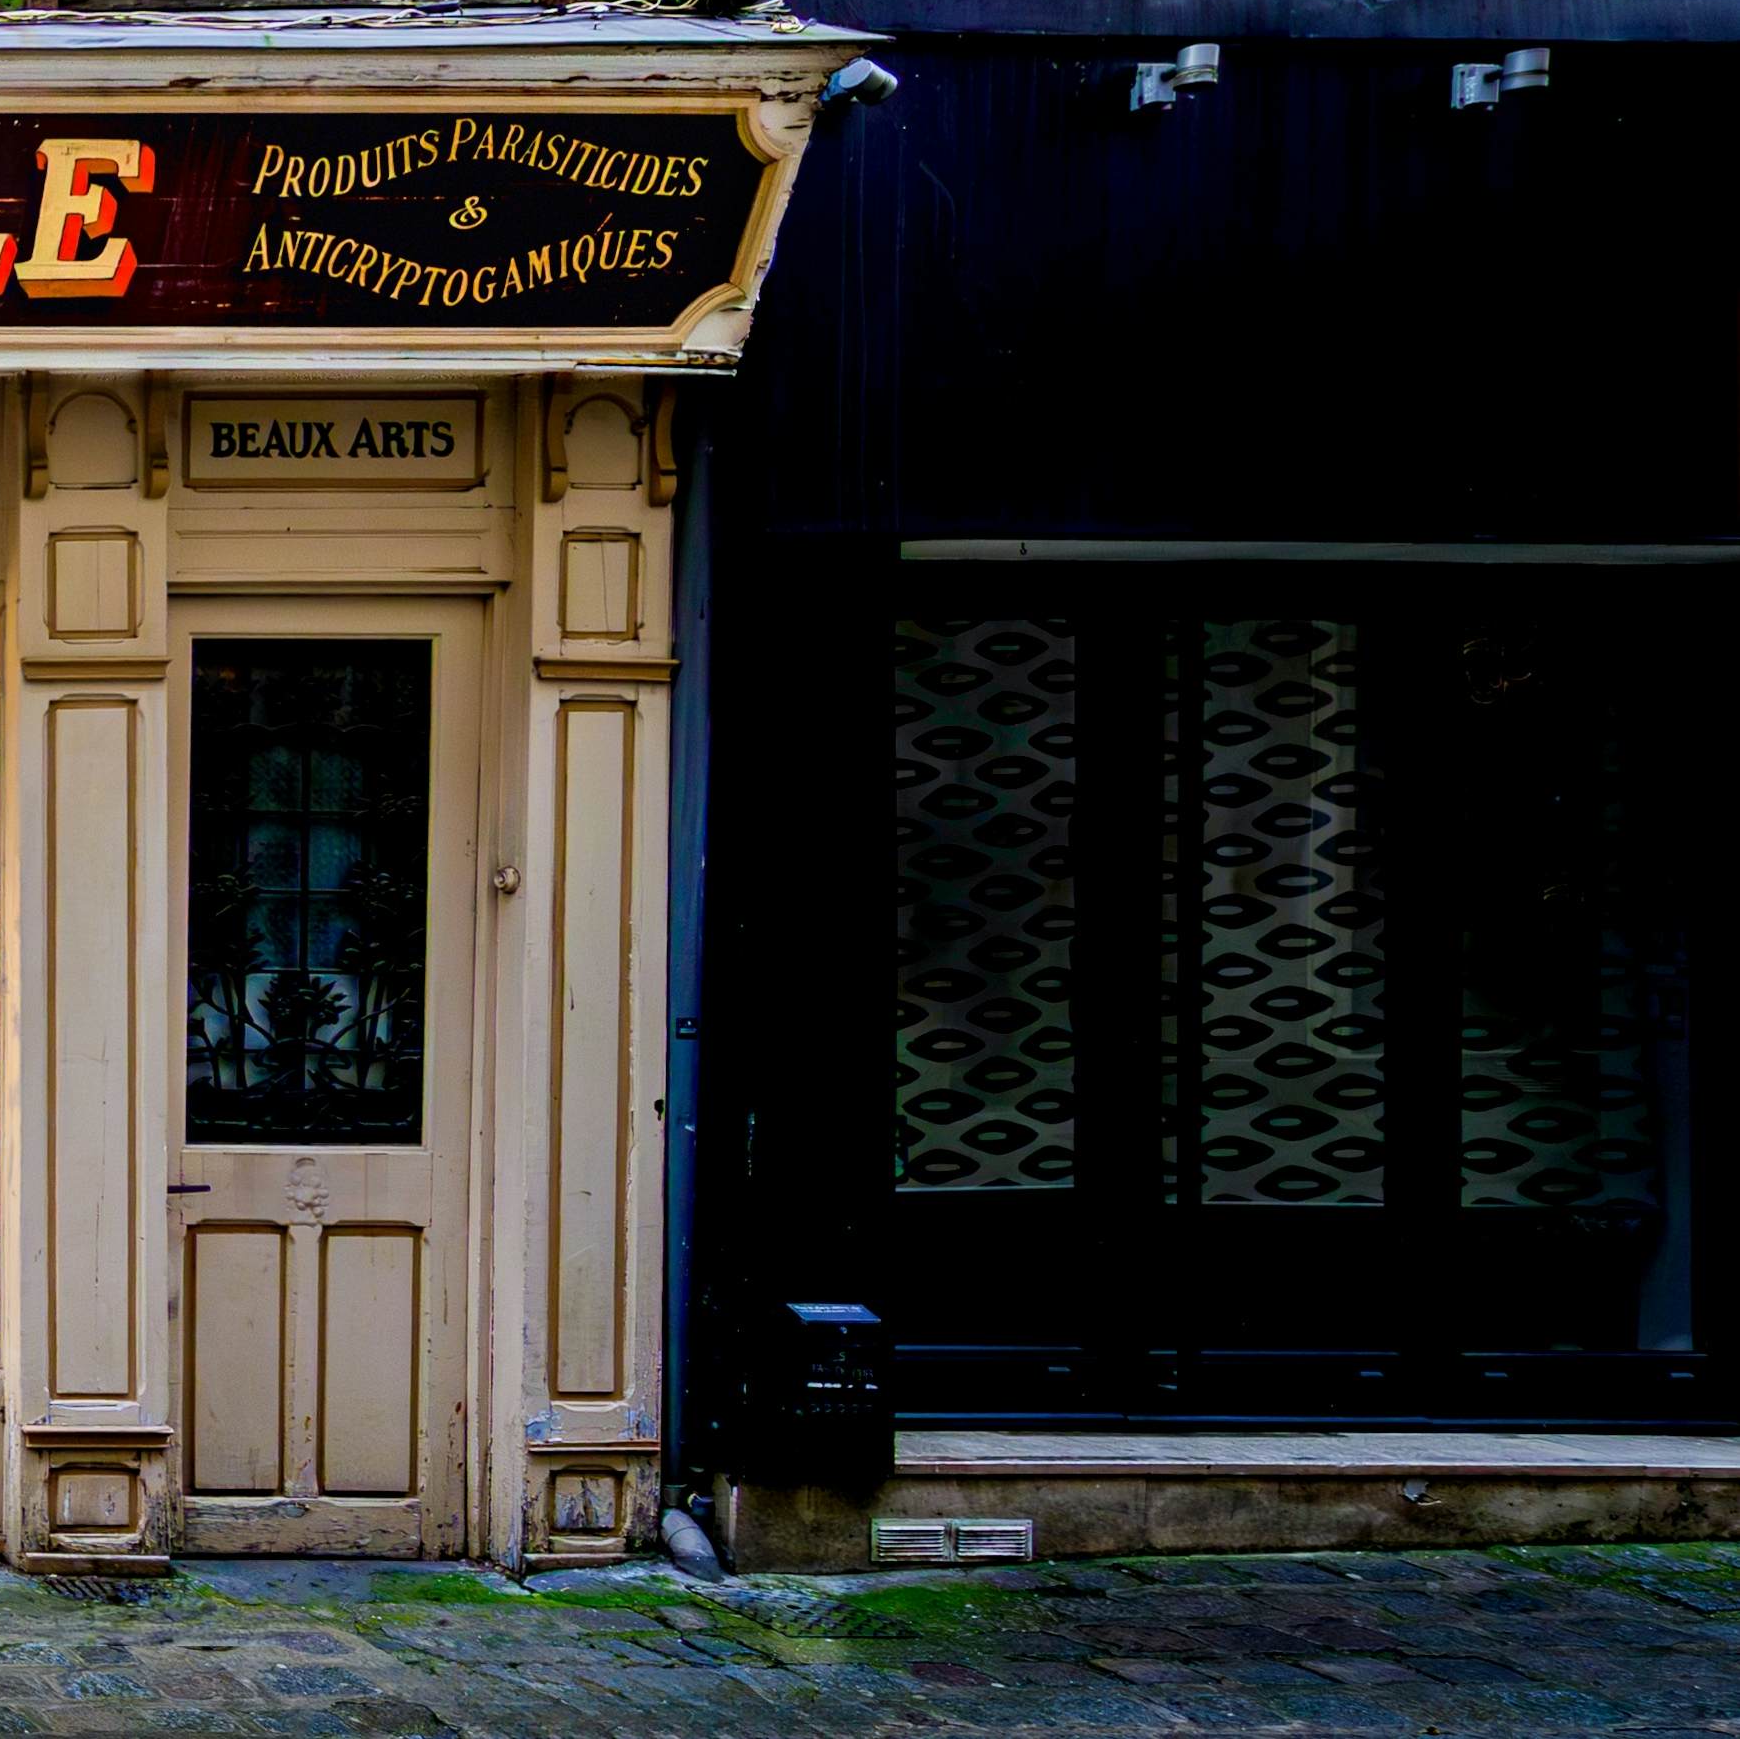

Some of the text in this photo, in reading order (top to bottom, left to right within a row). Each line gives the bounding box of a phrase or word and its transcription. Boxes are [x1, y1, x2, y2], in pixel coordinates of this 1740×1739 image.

[252, 117, 710, 198] PRODUITS PARASITICIDES
[448, 196, 488, 230] &
[242, 222, 679, 308] ANTICRYPTOGAMIQUES
[210, 418, 455, 459] BEAUX ARTS
